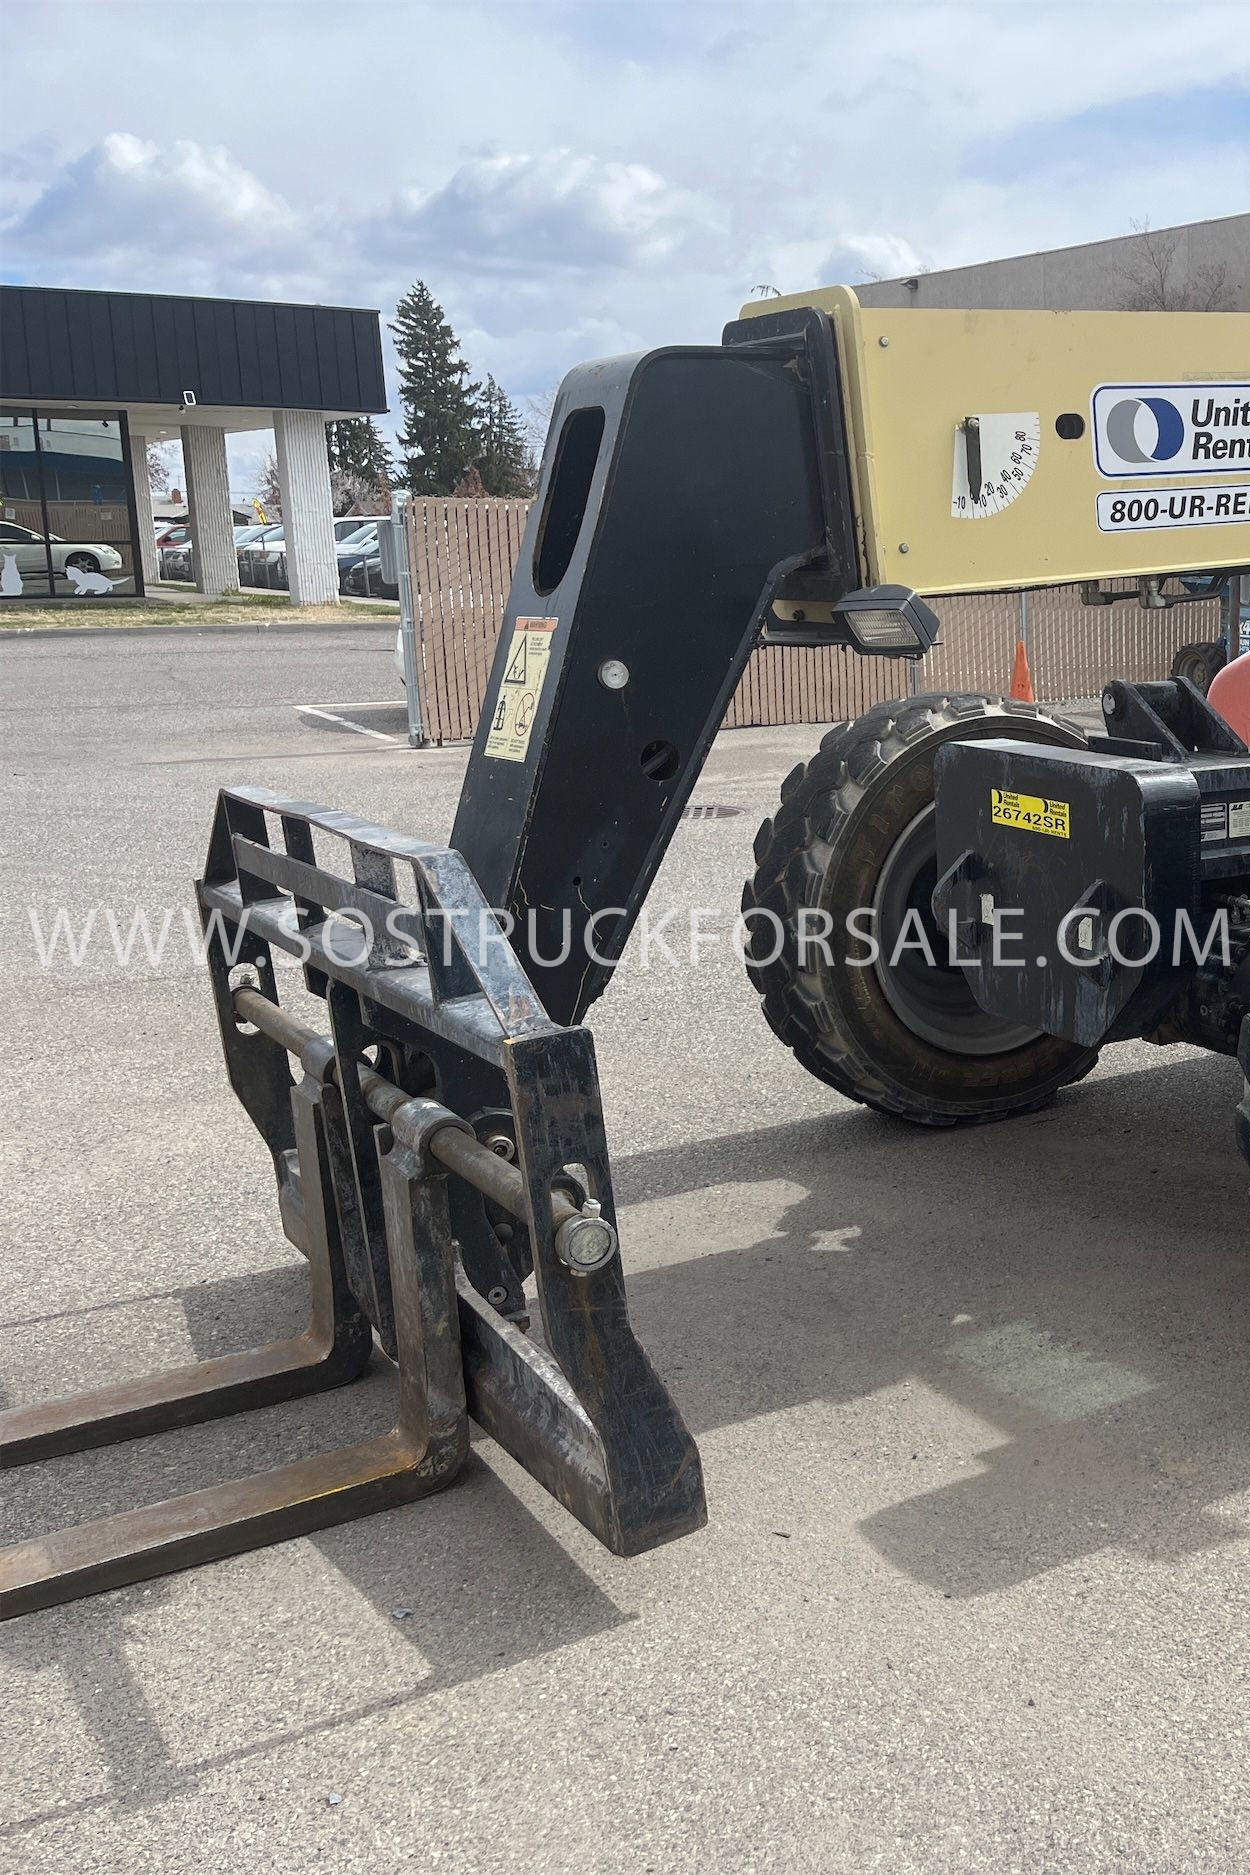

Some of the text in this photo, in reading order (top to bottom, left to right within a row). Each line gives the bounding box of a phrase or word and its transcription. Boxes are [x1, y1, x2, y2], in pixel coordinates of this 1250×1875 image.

[1014, 430, 1026, 442] 80
[1020, 443, 1032, 456] 70
[1010, 451, 1022, 465] 60
[1000, 469, 1012, 483] 40
[1011, 467, 1024, 481] 50
[984, 481, 995, 496] 20
[996, 484, 1008, 499] 30
[953, 495, 966, 510] -10
[1003, 792, 1019, 801] United
[1049, 801, 1066, 810] United
[993, 805, 1066, 831] 26742SR
